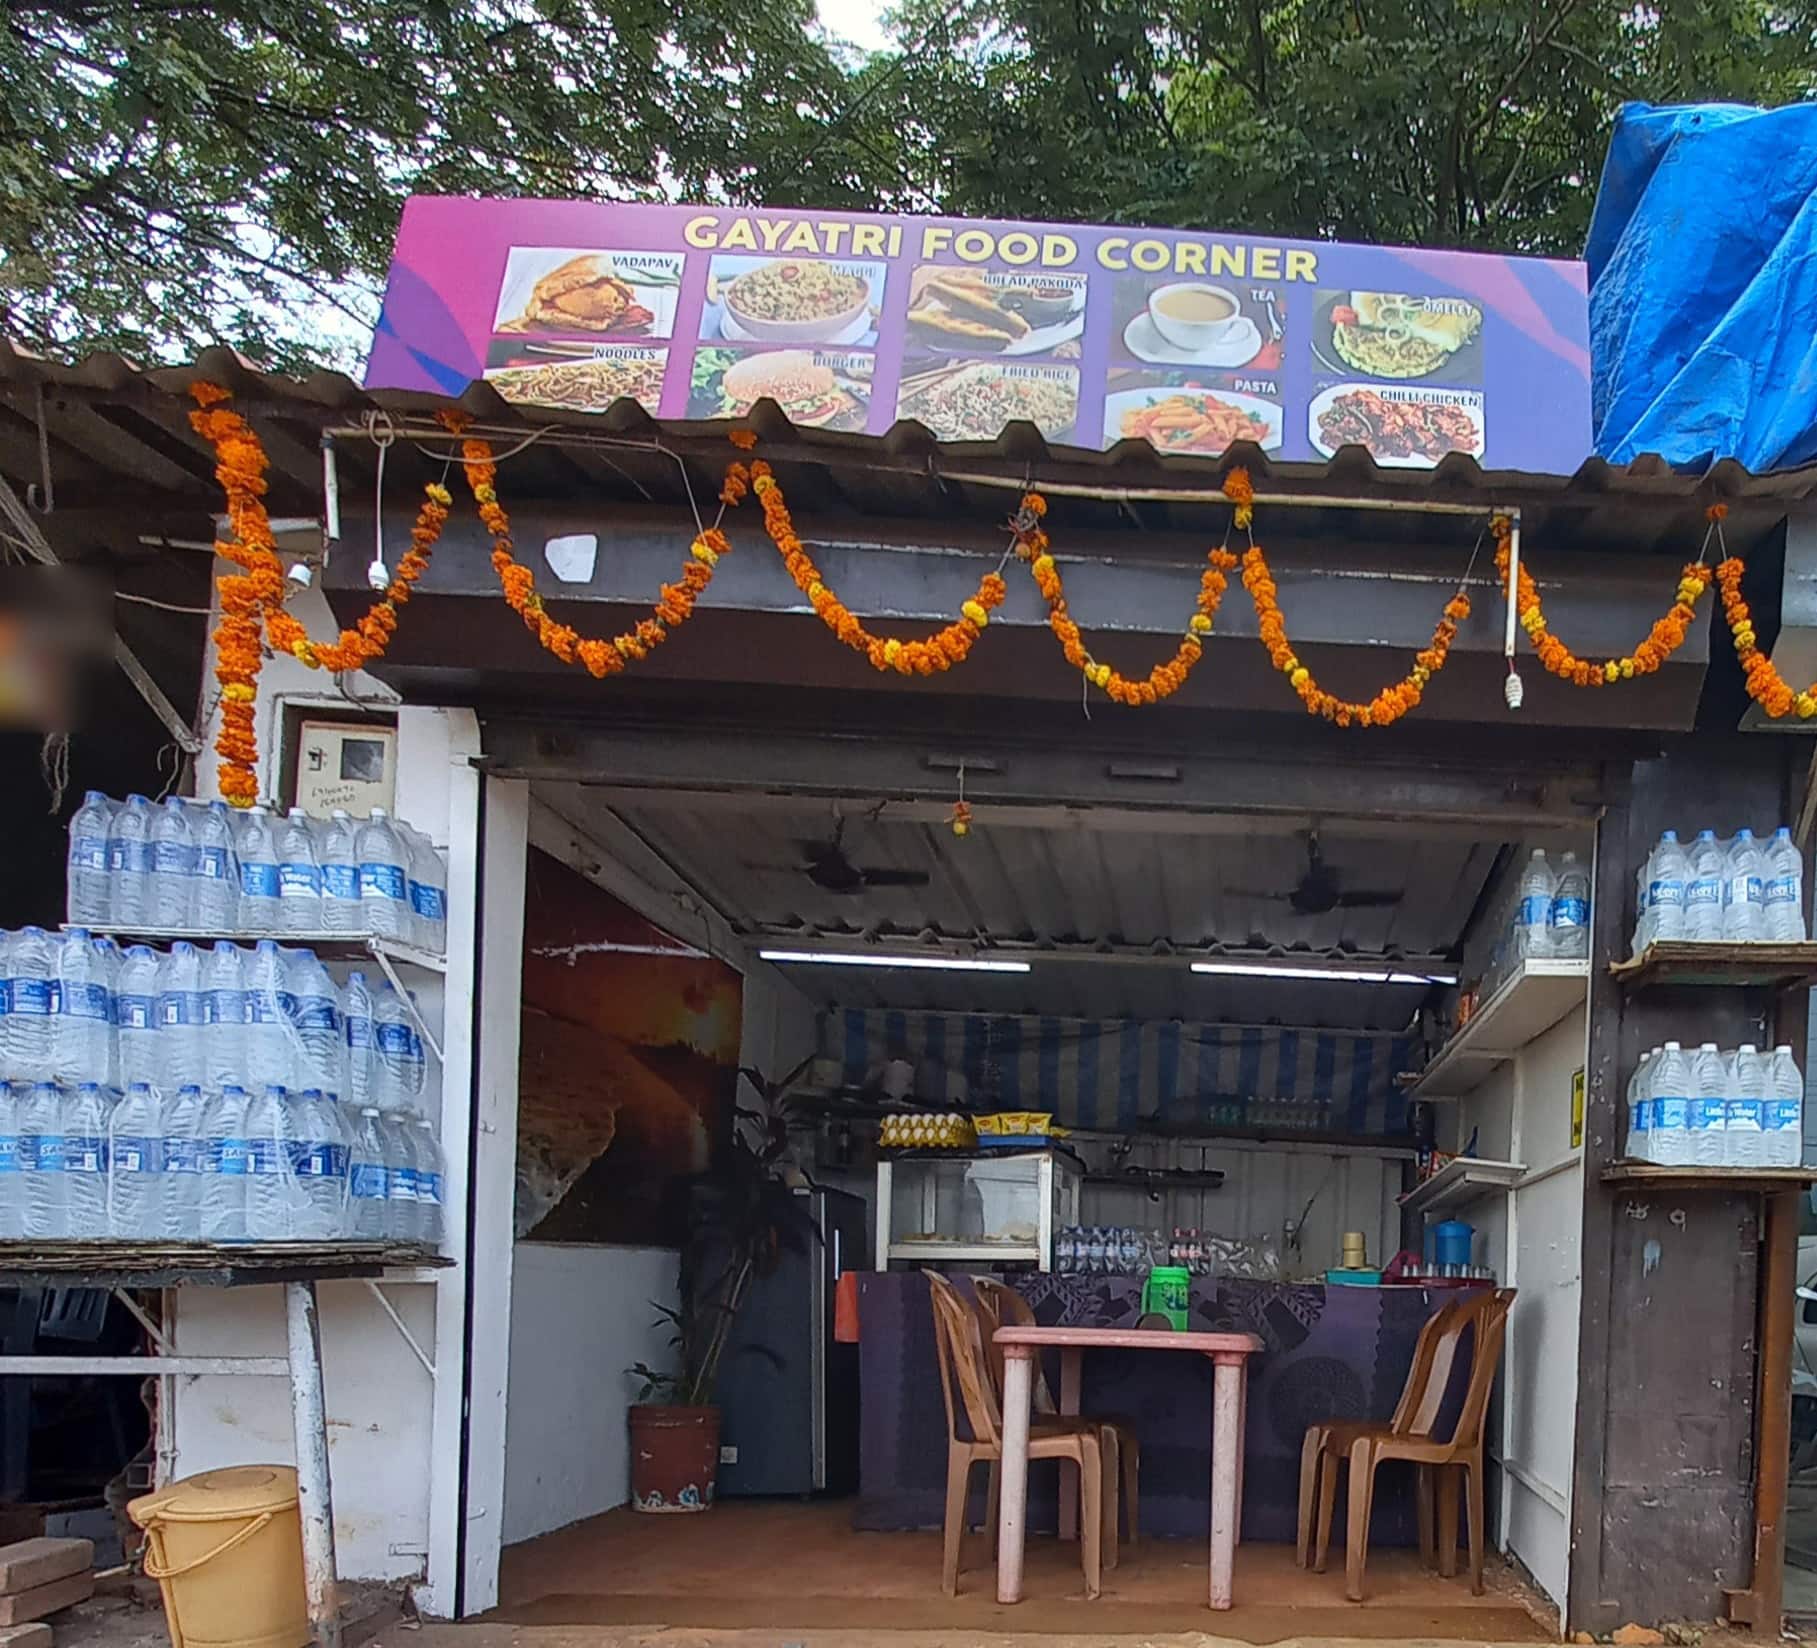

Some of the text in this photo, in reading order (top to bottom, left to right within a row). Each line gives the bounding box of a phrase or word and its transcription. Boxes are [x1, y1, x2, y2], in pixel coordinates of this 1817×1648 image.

[683, 215, 1319, 283] GAYATRI FOOD CORNER
[611, 255, 673, 268] VADAPAV
[1250, 289, 1276, 303] TEA
[593, 347, 657, 361] NOODLES
[1233, 379, 1278, 395] PASTA
[1423, 392, 1479, 407] CHICKEN
